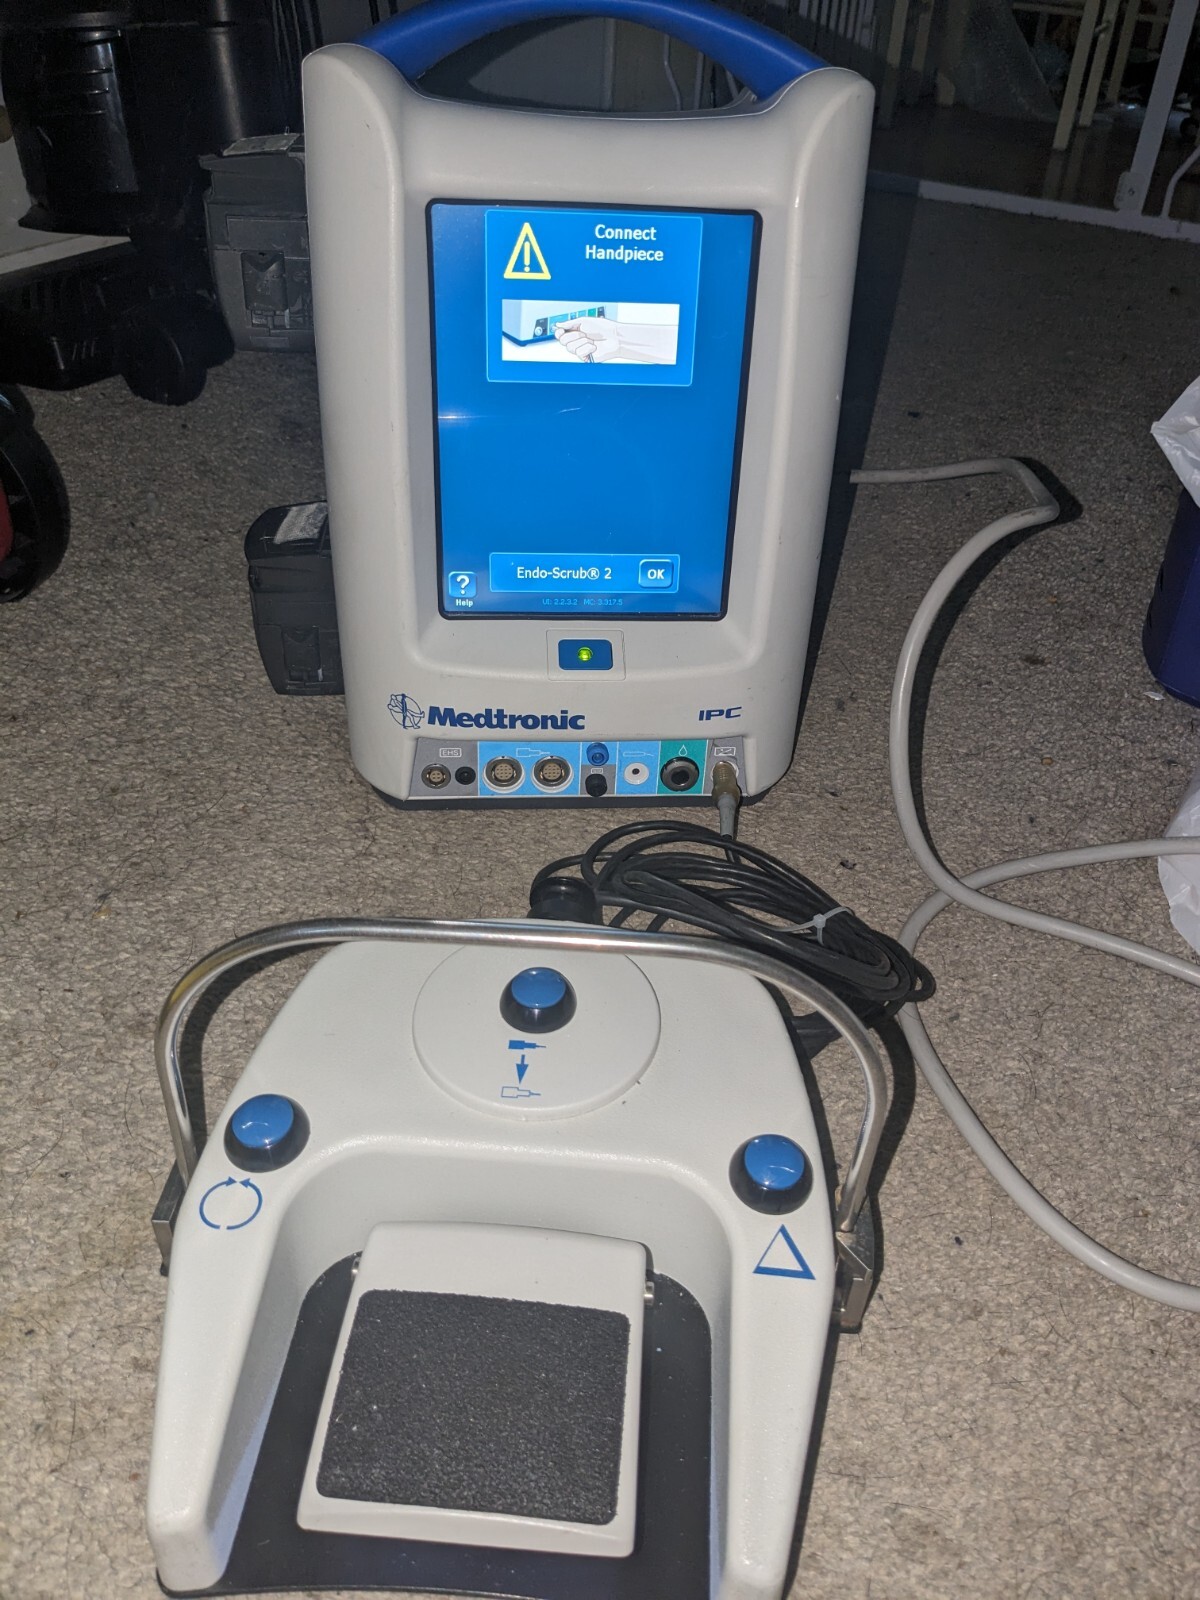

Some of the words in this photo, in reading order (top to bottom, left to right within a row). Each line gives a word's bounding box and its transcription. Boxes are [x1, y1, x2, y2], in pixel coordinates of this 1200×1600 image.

[595, 224, 657, 240] Connect
[585, 244, 664, 264] Handpiece
[516, 566, 600, 580] Endo-Scrub®
[604, 567, 612, 580] 2
[647, 568, 665, 580] OK
[455, 599, 474, 608] Help
[428, 706, 585, 730] Medtronic
[698, 706, 742, 721] IPC
